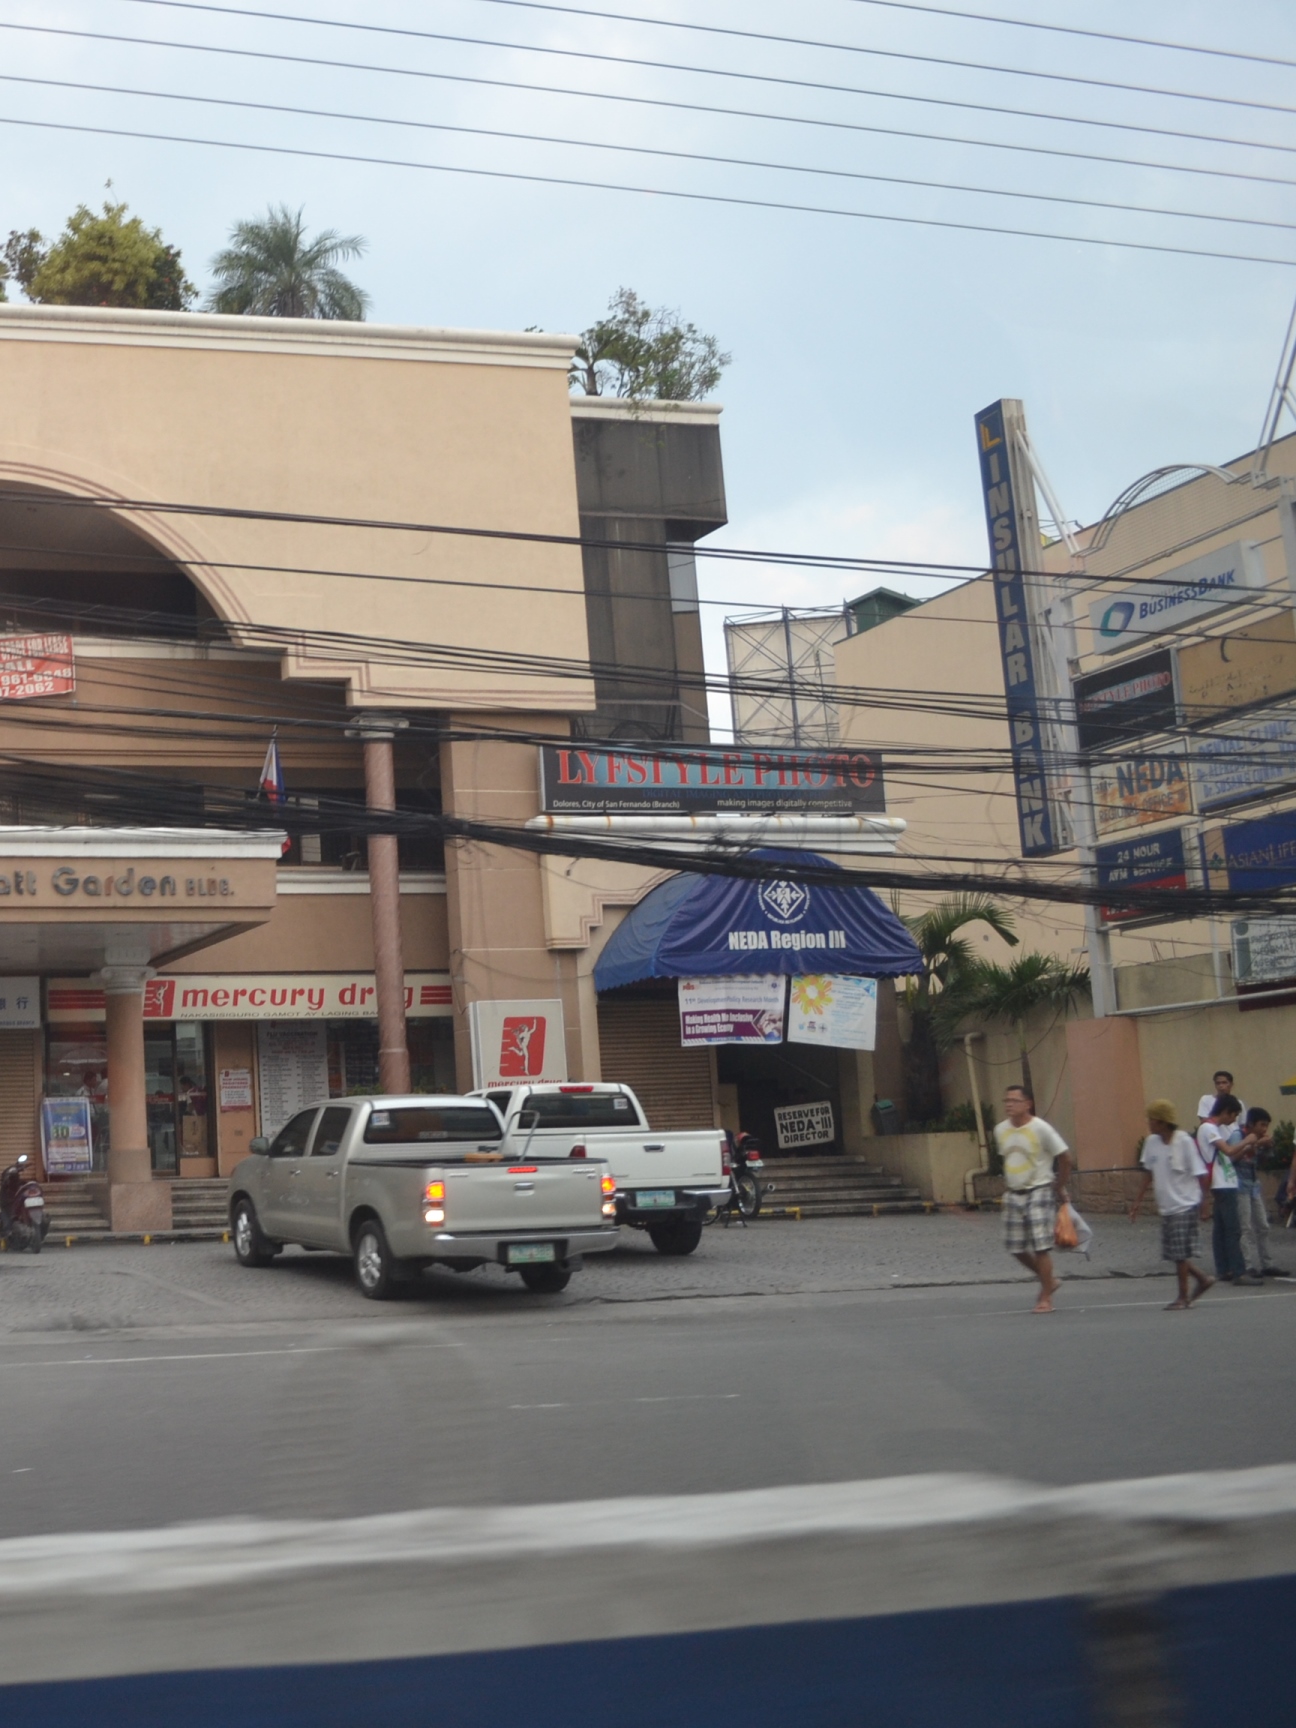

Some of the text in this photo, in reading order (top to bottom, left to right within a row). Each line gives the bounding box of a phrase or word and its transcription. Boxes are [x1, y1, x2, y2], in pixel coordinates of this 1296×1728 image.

[555, 750, 875, 788] LYFSTYLE PHOTO
[1116, 751, 1185, 798] NEDA
[553, 800, 581, 808] Dolores,
[582, 800, 596, 809] City
[597, 800, 604, 808] of
[652, 801, 680, 809] (Branch)
[717, 798, 746, 808] making
[747, 799, 775, 808] images
[776, 798, 806, 808] digitally
[1117, 843, 1161, 863] 24 HOUR
[52, 866, 177, 897] Garden
[729, 930, 846, 951] NEDA Region III
[181, 982, 414, 1011] mercury drg
[779, 1116, 832, 1135] NEDA-III
[784, 1130, 829, 1144] DIRECTOR
